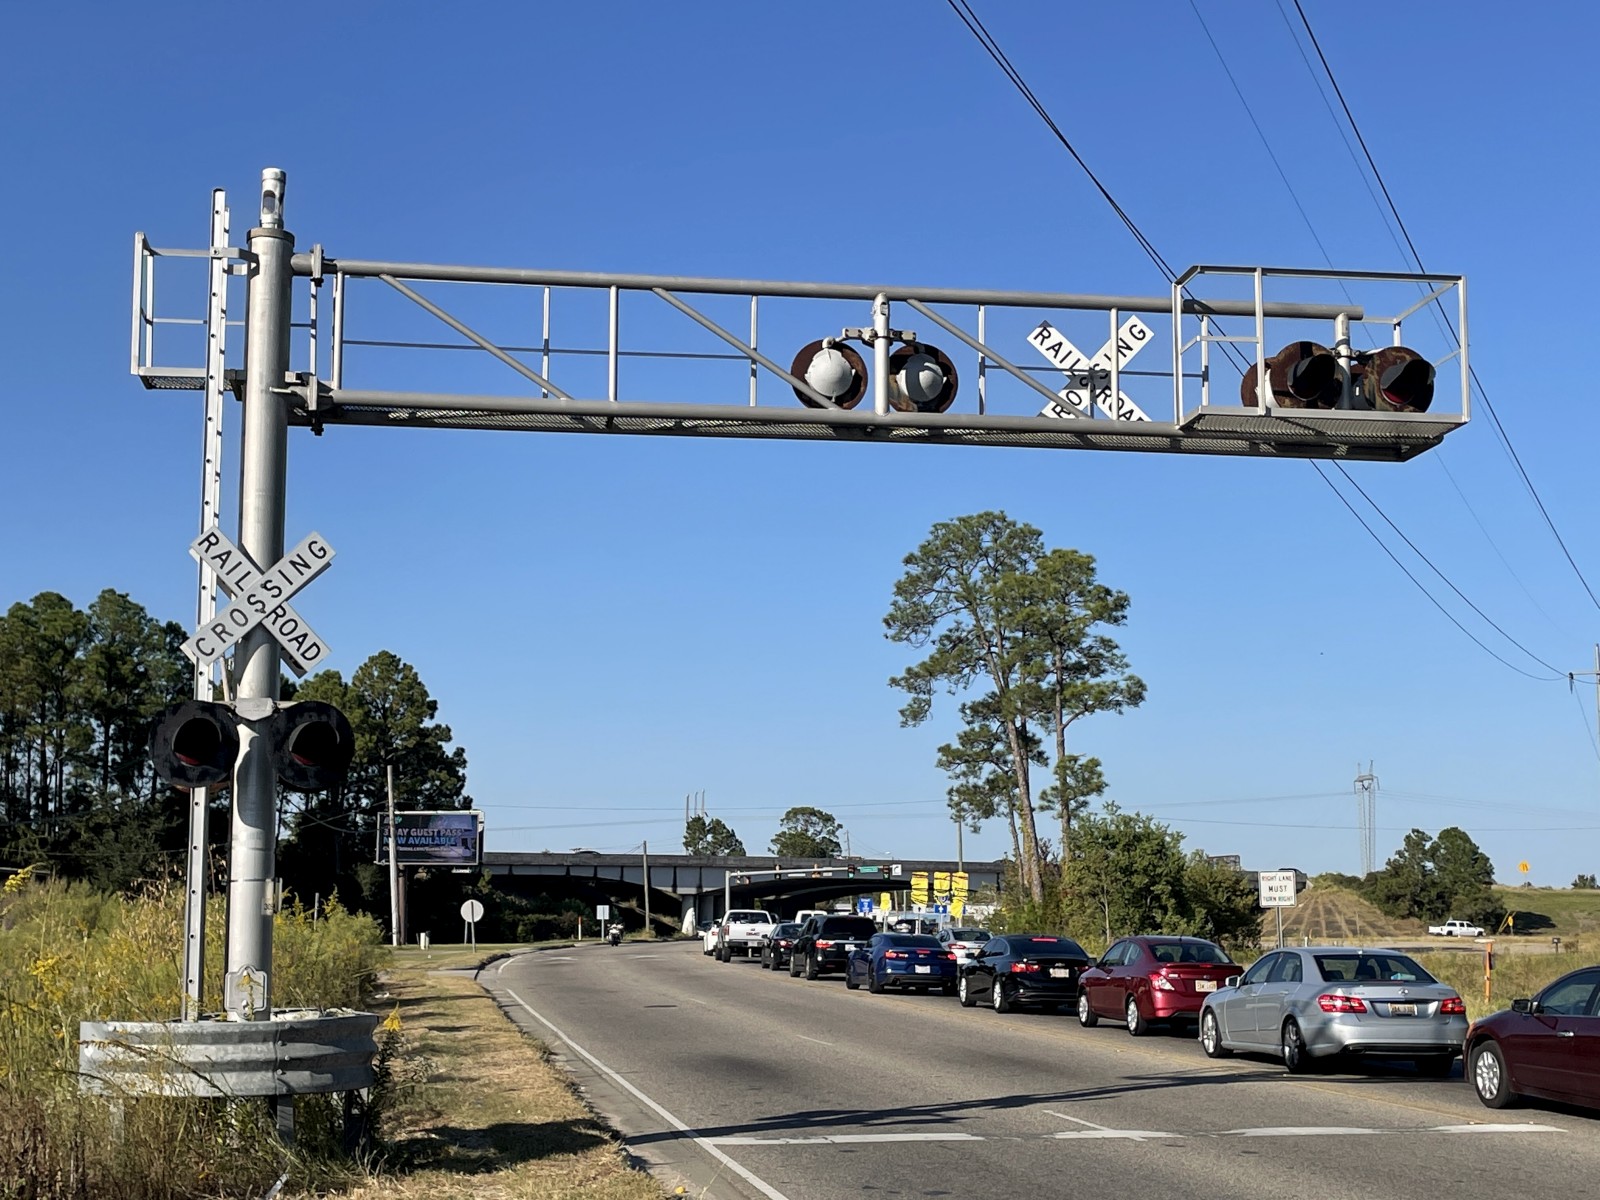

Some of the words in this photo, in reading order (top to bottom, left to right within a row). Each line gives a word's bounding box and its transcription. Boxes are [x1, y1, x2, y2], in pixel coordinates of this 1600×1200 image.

[1034, 327, 1080, 377] RAIL
[1096, 385, 1144, 421] ROA
[195, 540, 327, 657] CROSSING
[198, 531, 251, 592] RAIL
[266, 605, 321, 661] ROAD
[383, 837, 406, 845] NW
[408, 837, 455, 845] AVAILABLE
[410, 828, 438, 837] GUEST
